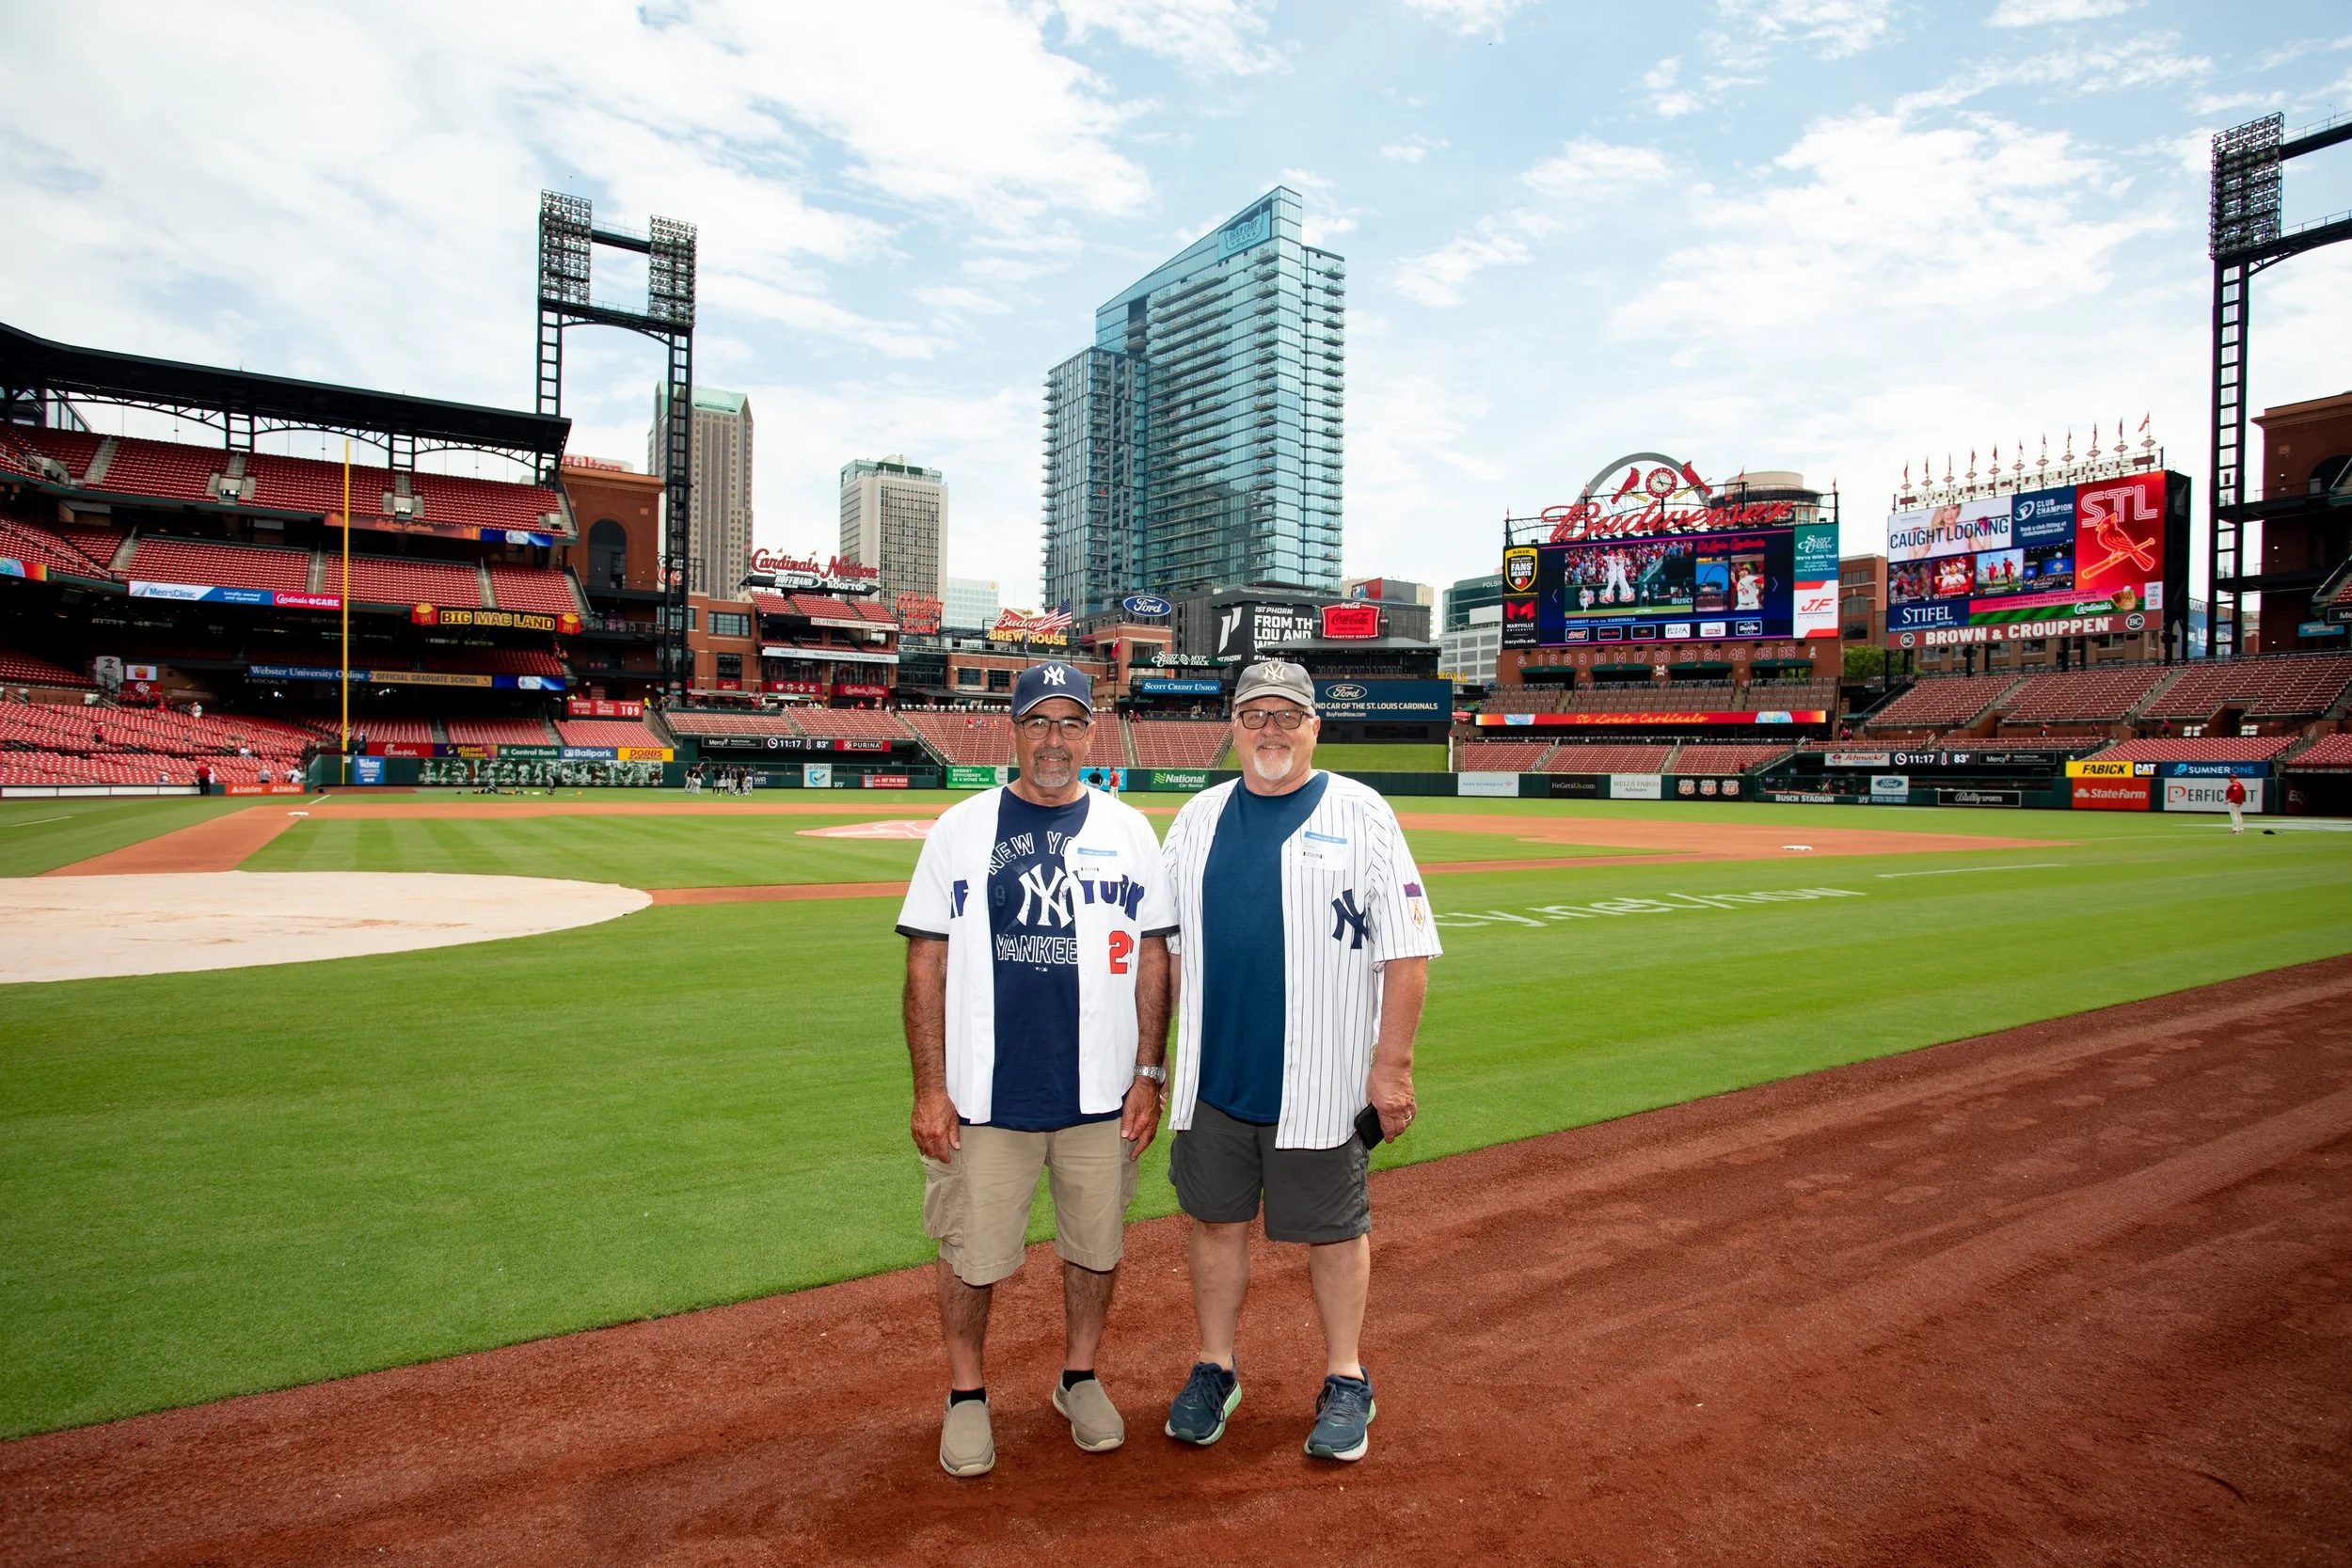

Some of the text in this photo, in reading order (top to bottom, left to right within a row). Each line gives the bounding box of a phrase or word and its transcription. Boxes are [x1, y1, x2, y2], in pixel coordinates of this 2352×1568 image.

[1915, 459, 2134, 504] WORLD CHAMPIONS
[2036, 499, 2055, 508] CLUB
[2036, 504, 2074, 515] CHAMPION
[2081, 485, 2158, 529] STL
[1541, 500, 1792, 544] Budweiser
[1890, 518, 2009, 549] CAUGHT LOOKING
[752, 548, 879, 579] Cardinals Nation
[1511, 562, 1534, 571] FANS'
[775, 575, 814, 587] HOFFMANN
[827, 582, 867, 591] ROOFTOP
[277, 594, 308, 604] Cardinals
[1134, 598, 1163, 613] Ford
[2075, 602, 2112, 614] Cardinals
[440, 611, 555, 630] BIG MAC LAND
[1332, 612, 1370, 625] Coca-Cola
[1902, 606, 1953, 625] STIFEL
[2128, 617, 2141, 626] BC
[1254, 615, 1293, 629] FROM
[1254, 627, 1311, 641] LOU AND
[1925, 617, 2109, 645] BROWN & CROUPPEN
[990, 630, 1067, 645] BREW HOUSE
[1902, 636, 1914, 644] BC
[1537, 646, 1795, 665] 1 2 6 9 10 14 17 20 23 24 42 45 85
[250, 666, 365, 679] Webster University Oline
[1042, 665, 1067, 686] NY
[1263, 663, 1286, 680] NY
[376, 672, 478, 685] OFFICIAL GRADUATE SCHOOL
[1332, 686, 1360, 698] Ford
[621, 706, 640, 715] 109
[1576, 713, 1708, 723] St. Louis Cardinals
[780, 739, 802, 748] 11:17
[575, 749, 612, 758] Ballpark
[1909, 754, 1934, 763] 11:17
[1954, 754, 1969, 763] 83°
[2083, 764, 2126, 775] FABICK
[2135, 764, 2156, 775] CAT
[2188, 766, 2254, 774] SUMNERONE
[1166, 774, 1205, 783] National
[1882, 779, 1899, 788] Ford
[1551, 782, 1596, 790] HeGetsUs.com
[1775, 794, 1834, 803] BUSCH STADIUM
[1955, 792, 1982, 804] Bally
[2090, 788, 2147, 800] StateFarm
[2167, 786, 2258, 803] PERFICT
[988, 832, 1076, 876] NEW YO
[1017, 863, 1073, 928] NY
[1332, 889, 1369, 950] NY
[995, 934, 1078, 965] YANKEE
